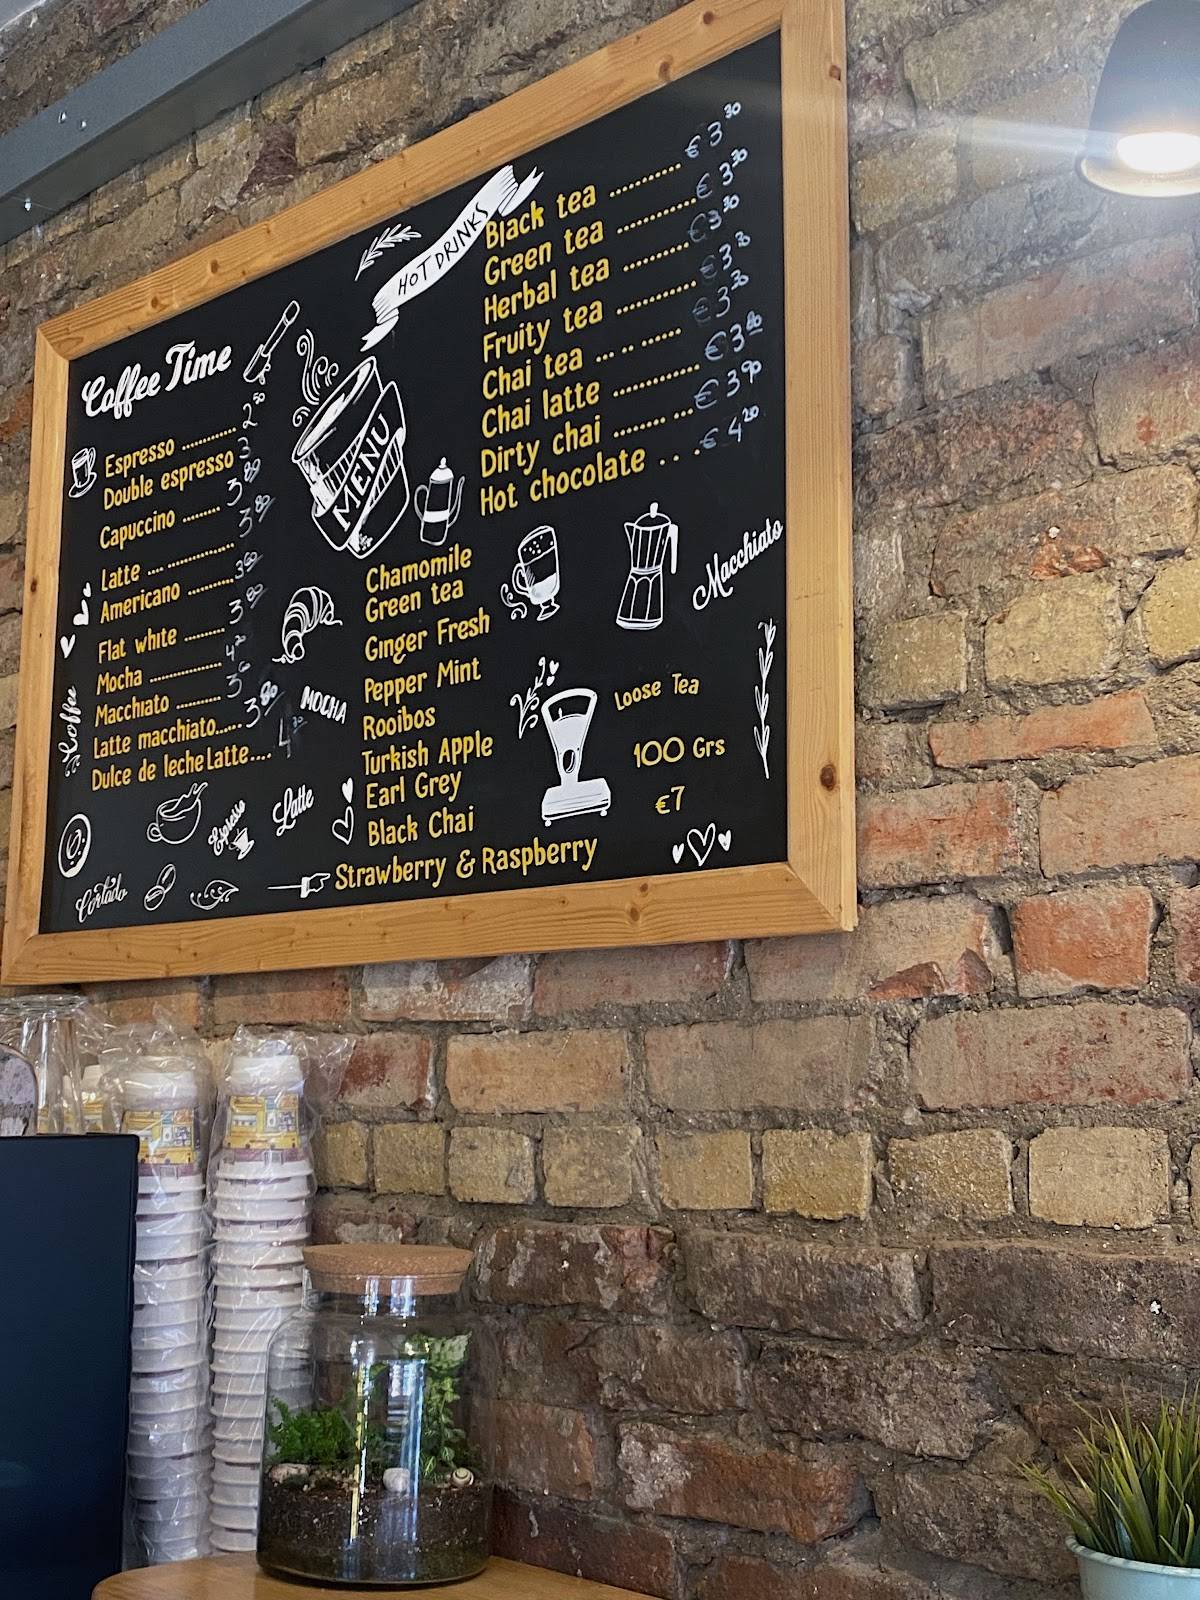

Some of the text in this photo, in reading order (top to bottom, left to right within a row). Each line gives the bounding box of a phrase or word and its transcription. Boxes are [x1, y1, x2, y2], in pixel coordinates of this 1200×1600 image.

[485, 200, 545, 249] Black
[556, 184, 597, 220] tea
[398, 202, 489, 295] HOT DRINKS
[484, 241, 552, 286] Green
[564, 220, 604, 255] tea
[484, 269, 557, 325] Herbal
[570, 258, 610, 292] tea
[483, 319, 550, 363] Fruity
[563, 300, 603, 334] tea
[81, 340, 232, 420] Coffee Time
[482, 359, 532, 400] Chai
[543, 347, 583, 380] tea
[481, 398, 531, 439] Chai
[543, 381, 600, 420] latte
[105, 438, 175, 478] Espresso
[481, 439, 540, 478] Dirty
[552, 415, 601, 455] chai
[104, 474, 153, 511] Double
[160, 450, 235, 491] espresso
[332, 413, 390, 532] MENU
[480, 483, 518, 517] Hot
[529, 448, 646, 502] chocolate
[100, 509, 176, 550] Capuccino
[101, 563, 141, 592] Latte
[365, 543, 472, 594] Chamomile
[692, 518, 783, 611] Macchiato
[100, 582, 181, 624] Americano
[365, 579, 464, 623] Green tea
[98, 638, 127, 664] Flat
[134, 627, 178, 655] white
[364, 606, 491, 665] Ginger Fresh
[96, 665, 143, 696] Mocha
[300, 685, 347, 725] MOCHA
[364, 656, 482, 707] Pepper Mint
[614, 672, 700, 712] Loose Tea
[58, 684, 81, 764] Coffee
[95, 694, 170, 728] Macchiato
[363, 706, 436, 741] Rooibos
[91, 762, 132, 792] Dulce
[138, 762, 157, 783] de
[163, 752, 204, 779] leche
[94, 736, 131, 760] Latte
[361, 730, 494, 776] Turkish Apple
[633, 736, 725, 769] 100 Grs
[272, 784, 315, 838] Latte
[366, 770, 462, 810] Earl Grey
[367, 805, 475, 847] Black Chai
[334, 837, 598, 890] Strawberry & Raspberry
